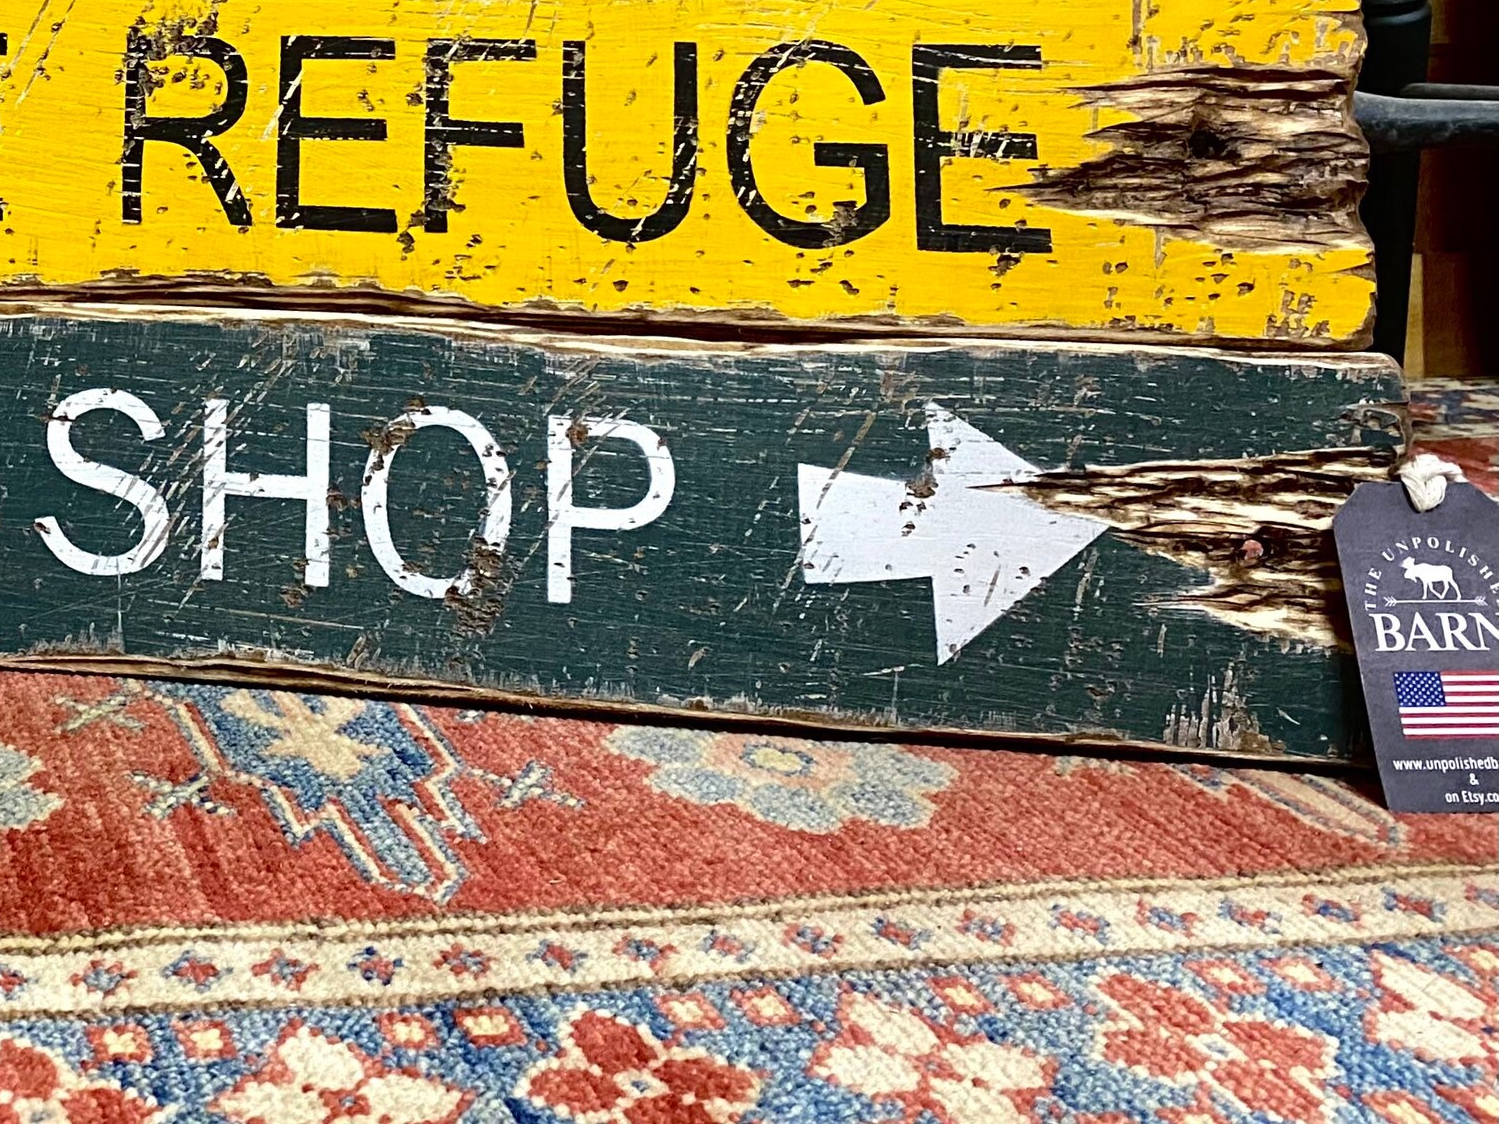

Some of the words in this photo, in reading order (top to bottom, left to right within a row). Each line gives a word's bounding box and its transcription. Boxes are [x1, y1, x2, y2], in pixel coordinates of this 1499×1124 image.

[121, 33, 1053, 253] REFUGE
[34, 387, 677, 604] SHOP
[1364, 567, 1382, 611] THE
[1381, 536, 1499, 607] UNPOLISHE
[1368, 611, 1499, 652] BARN
[1445, 792, 1460, 803] on
[1469, 772, 1480, 786] &
